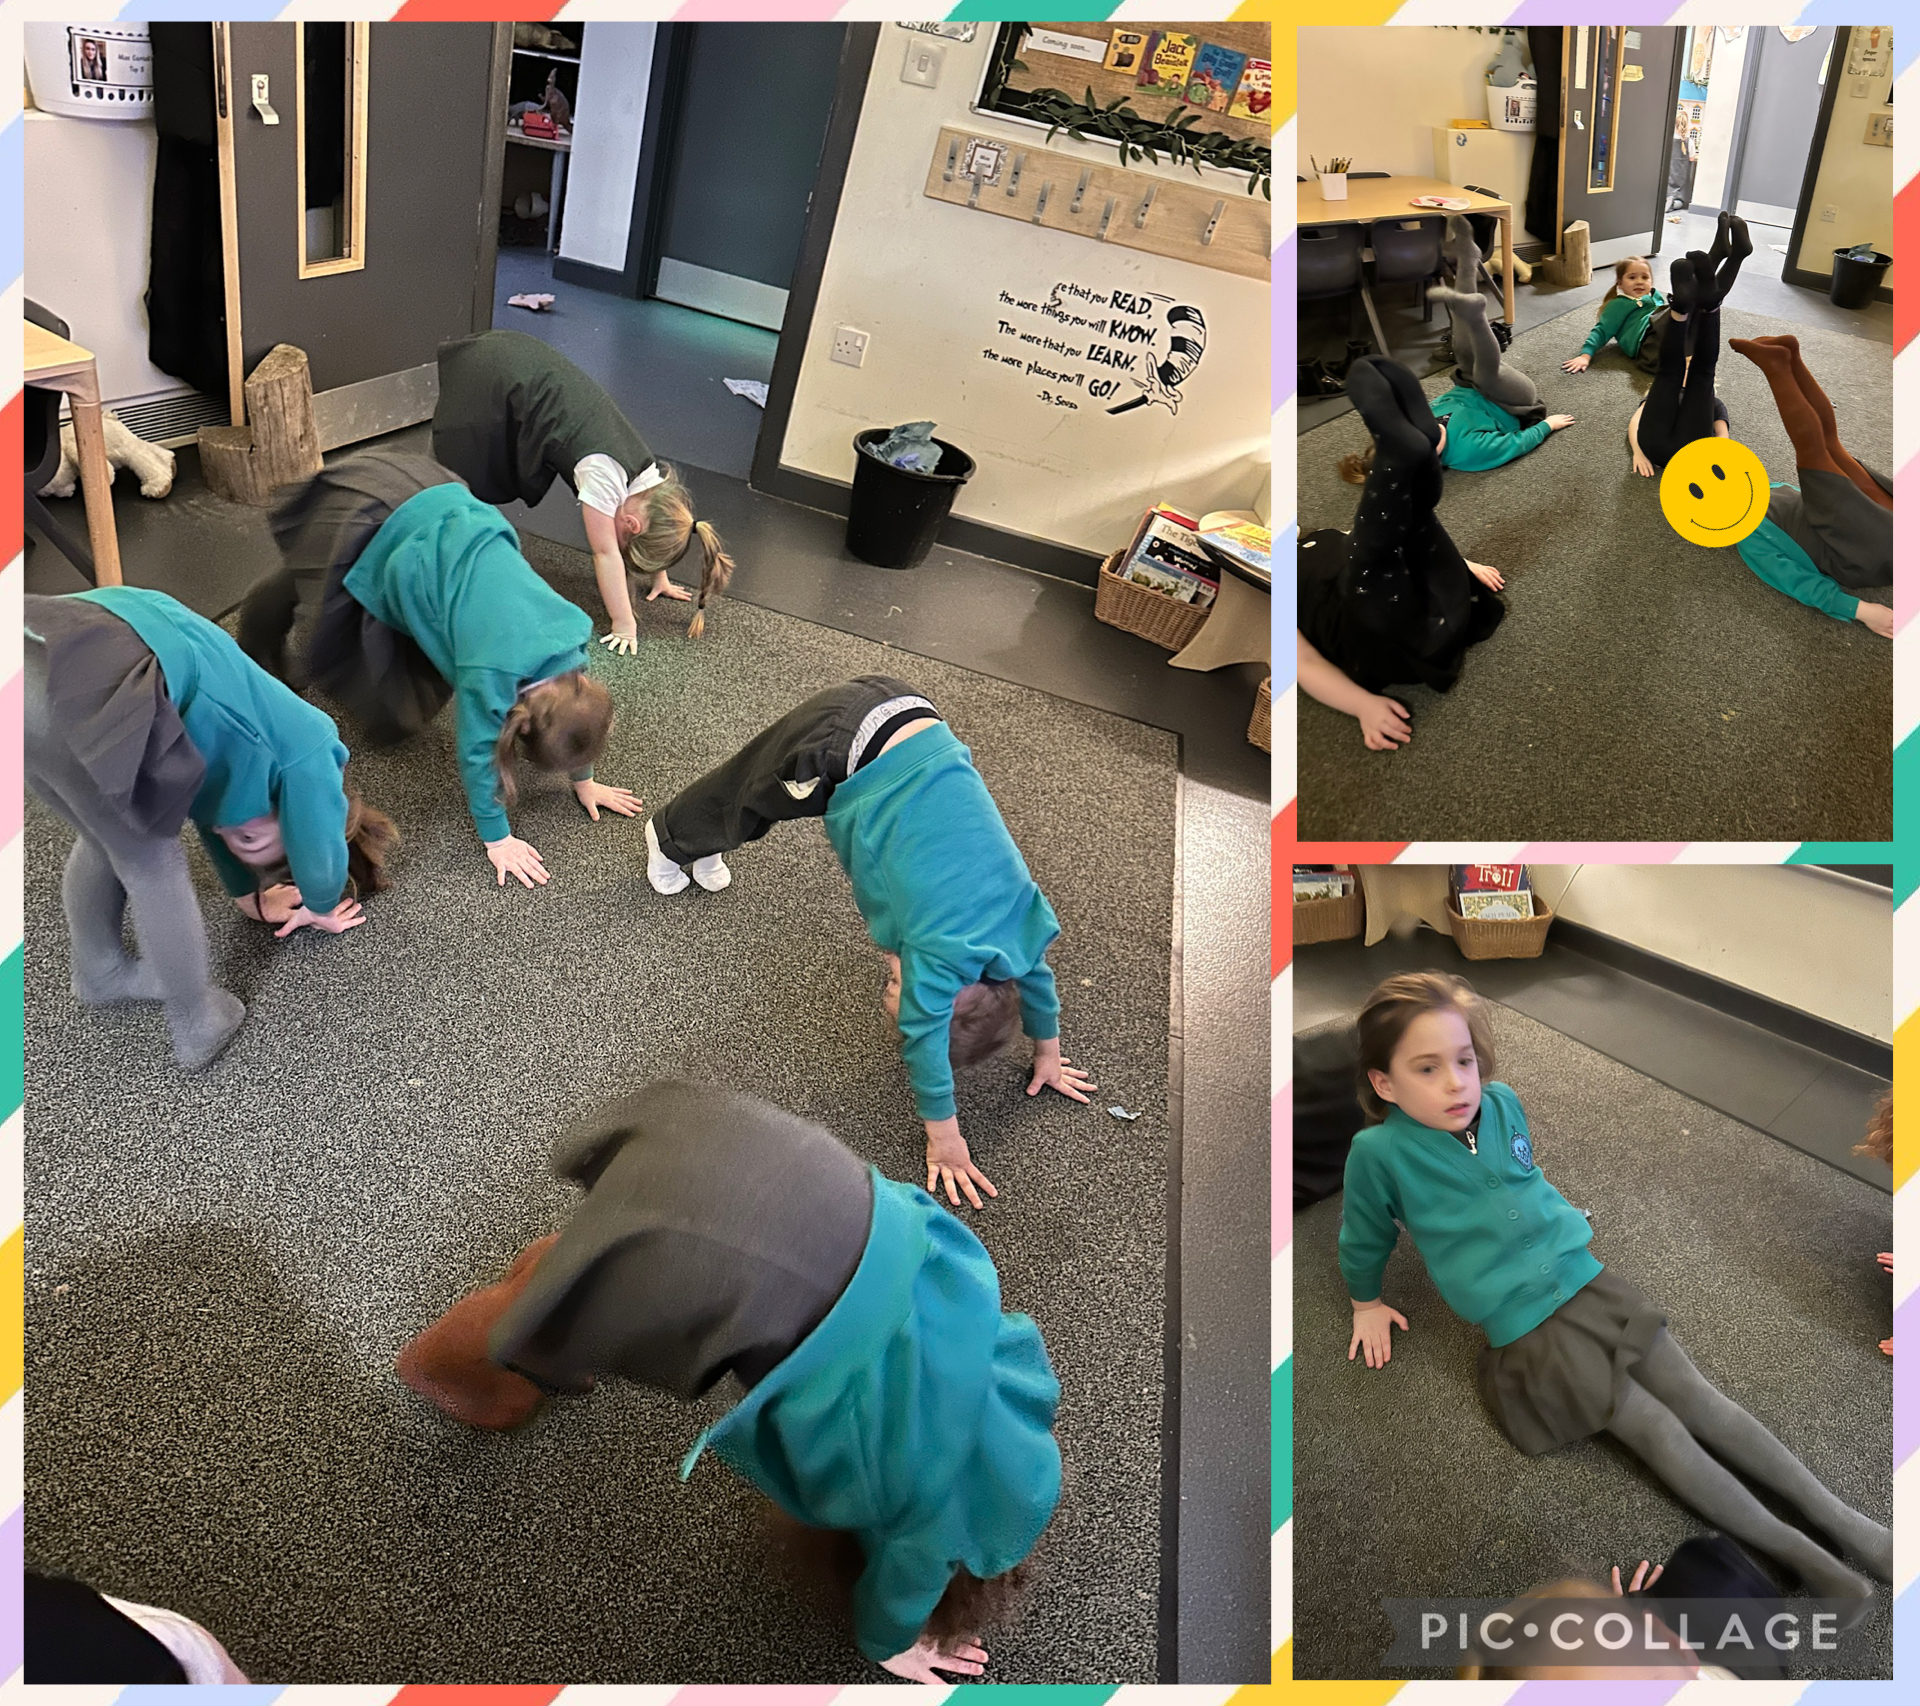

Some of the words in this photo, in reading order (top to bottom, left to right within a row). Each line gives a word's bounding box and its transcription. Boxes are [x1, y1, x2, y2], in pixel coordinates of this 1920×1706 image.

[1042, 36, 1069, 50] Coming
[1162, 40, 1188, 56] Jack
[1068, 283, 1091, 301] that
[1089, 293, 1108, 304] you
[1109, 289, 1153, 319] READ,
[999, 290, 1016, 305] the
[1016, 300, 1038, 312] more
[1041, 302, 1071, 324] things
[1069, 316, 1088, 326] you
[1088, 319, 1107, 334] will
[1108, 319, 1158, 347] KNOW.
[998, 320, 1017, 335] The
[1020, 332, 1042, 346] more
[1043, 336, 1066, 354] that
[1063, 346, 1082, 357] you
[1086, 344, 1138, 372] LEARN,
[983, 348, 999, 361] the
[1000, 356, 1023, 368] more
[1025, 360, 1058, 379] places
[1057, 373, 1085, 387] you'll
[1088, 378, 1121, 400] GO!
[1054, 395, 1078, 410] Seuss
[1162, 523, 1178, 538] The
[1180, 532, 1198, 547] Tige
[1475, 864, 1514, 888] Troll
